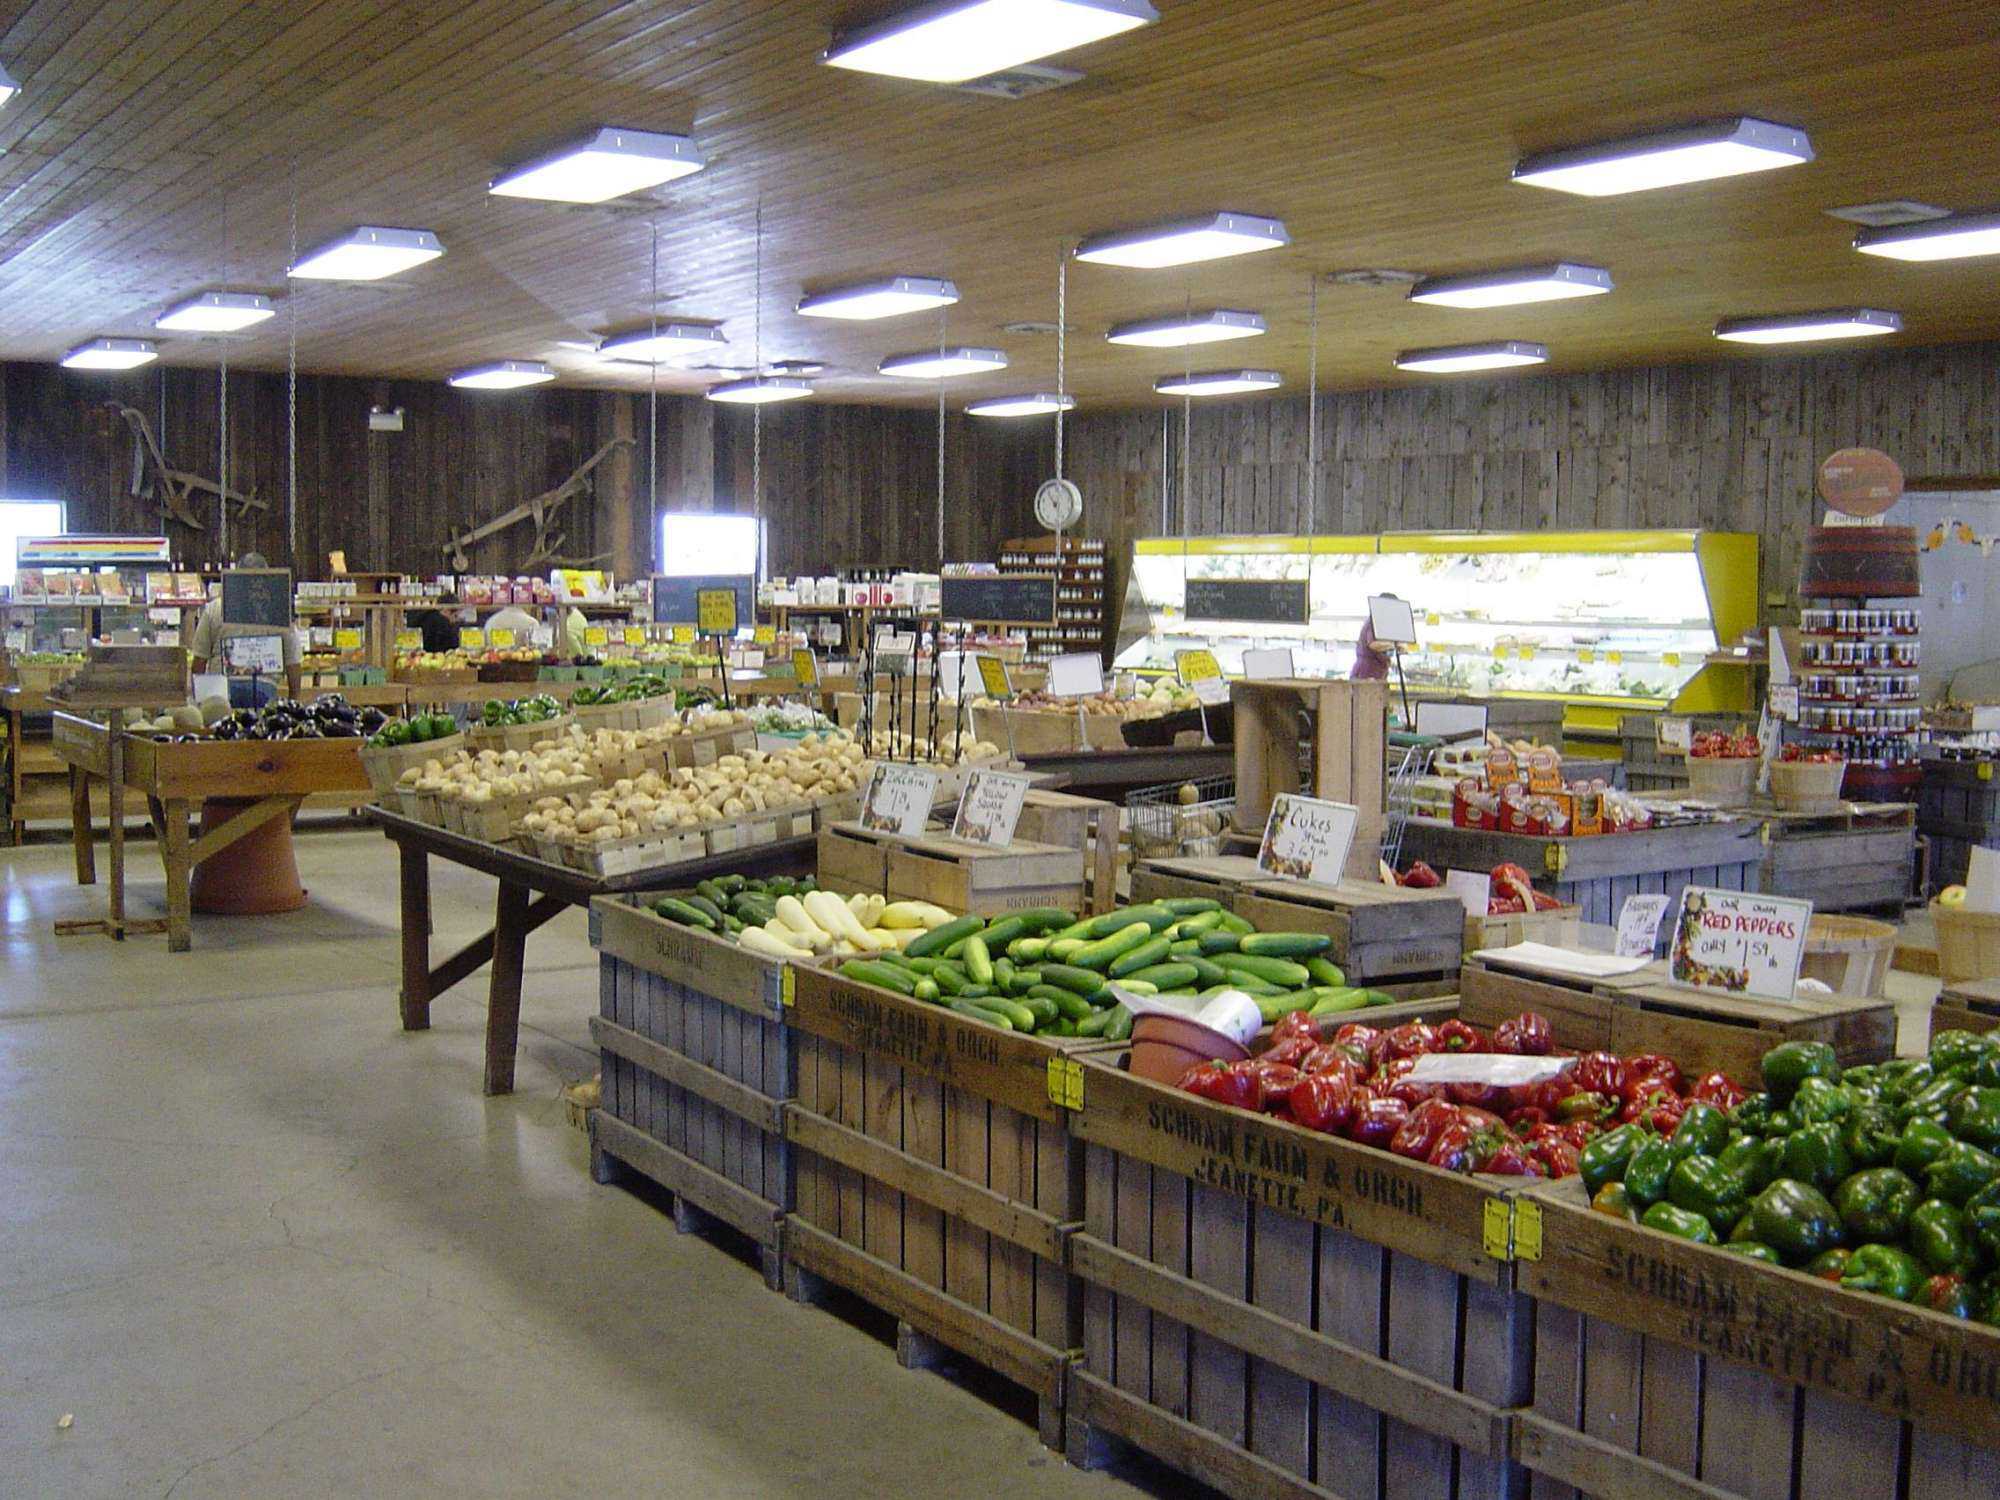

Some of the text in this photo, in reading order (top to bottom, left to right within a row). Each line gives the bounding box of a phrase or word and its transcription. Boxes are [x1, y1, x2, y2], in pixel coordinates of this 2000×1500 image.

[1290, 805, 1332, 833] Cukes
[1703, 911, 1796, 940] RED PEPPERS
[1244, 1132, 1309, 1183] FARM
[1324, 1157, 1342, 1190] &
